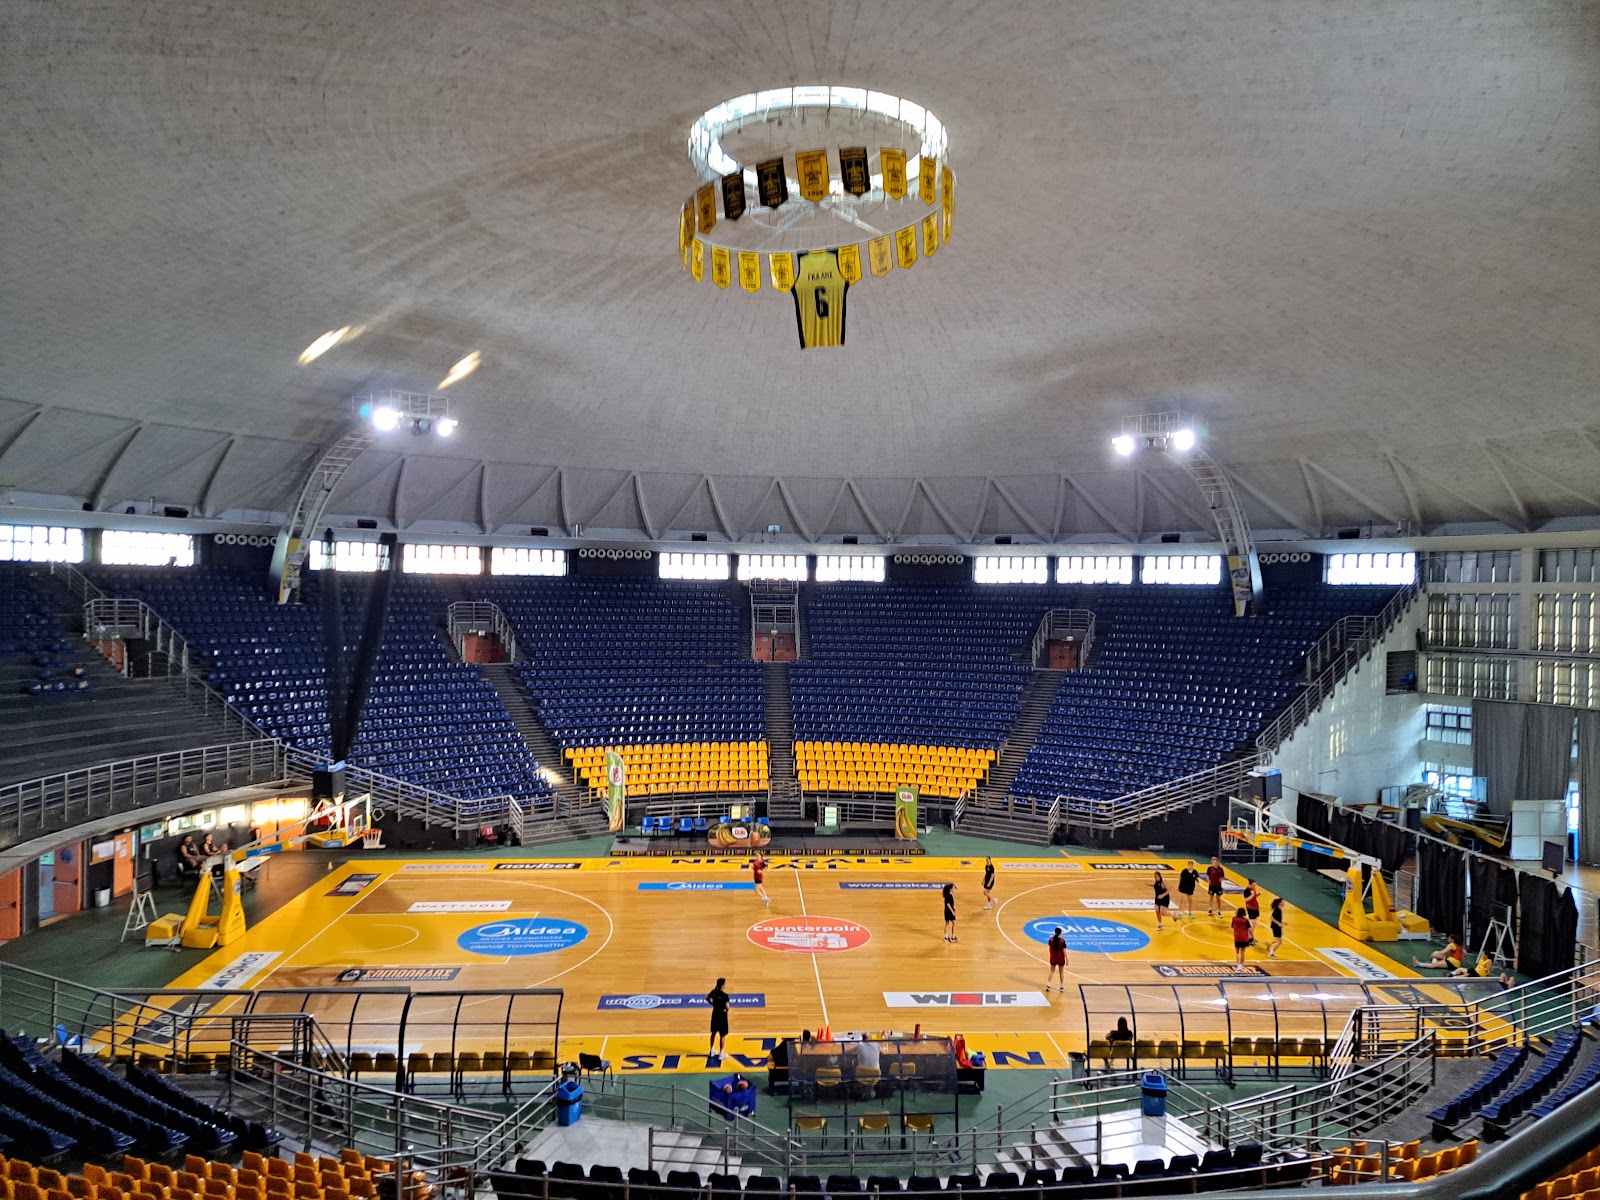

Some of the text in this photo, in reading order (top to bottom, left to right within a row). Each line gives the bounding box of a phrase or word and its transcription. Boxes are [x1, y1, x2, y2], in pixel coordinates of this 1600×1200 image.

[814, 285, 829, 318] 6
[489, 925, 577, 936] Midea
[752, 925, 862, 933] Counterpain
[1047, 924, 1131, 933] Midea
[909, 993, 1018, 1005] WOLF
